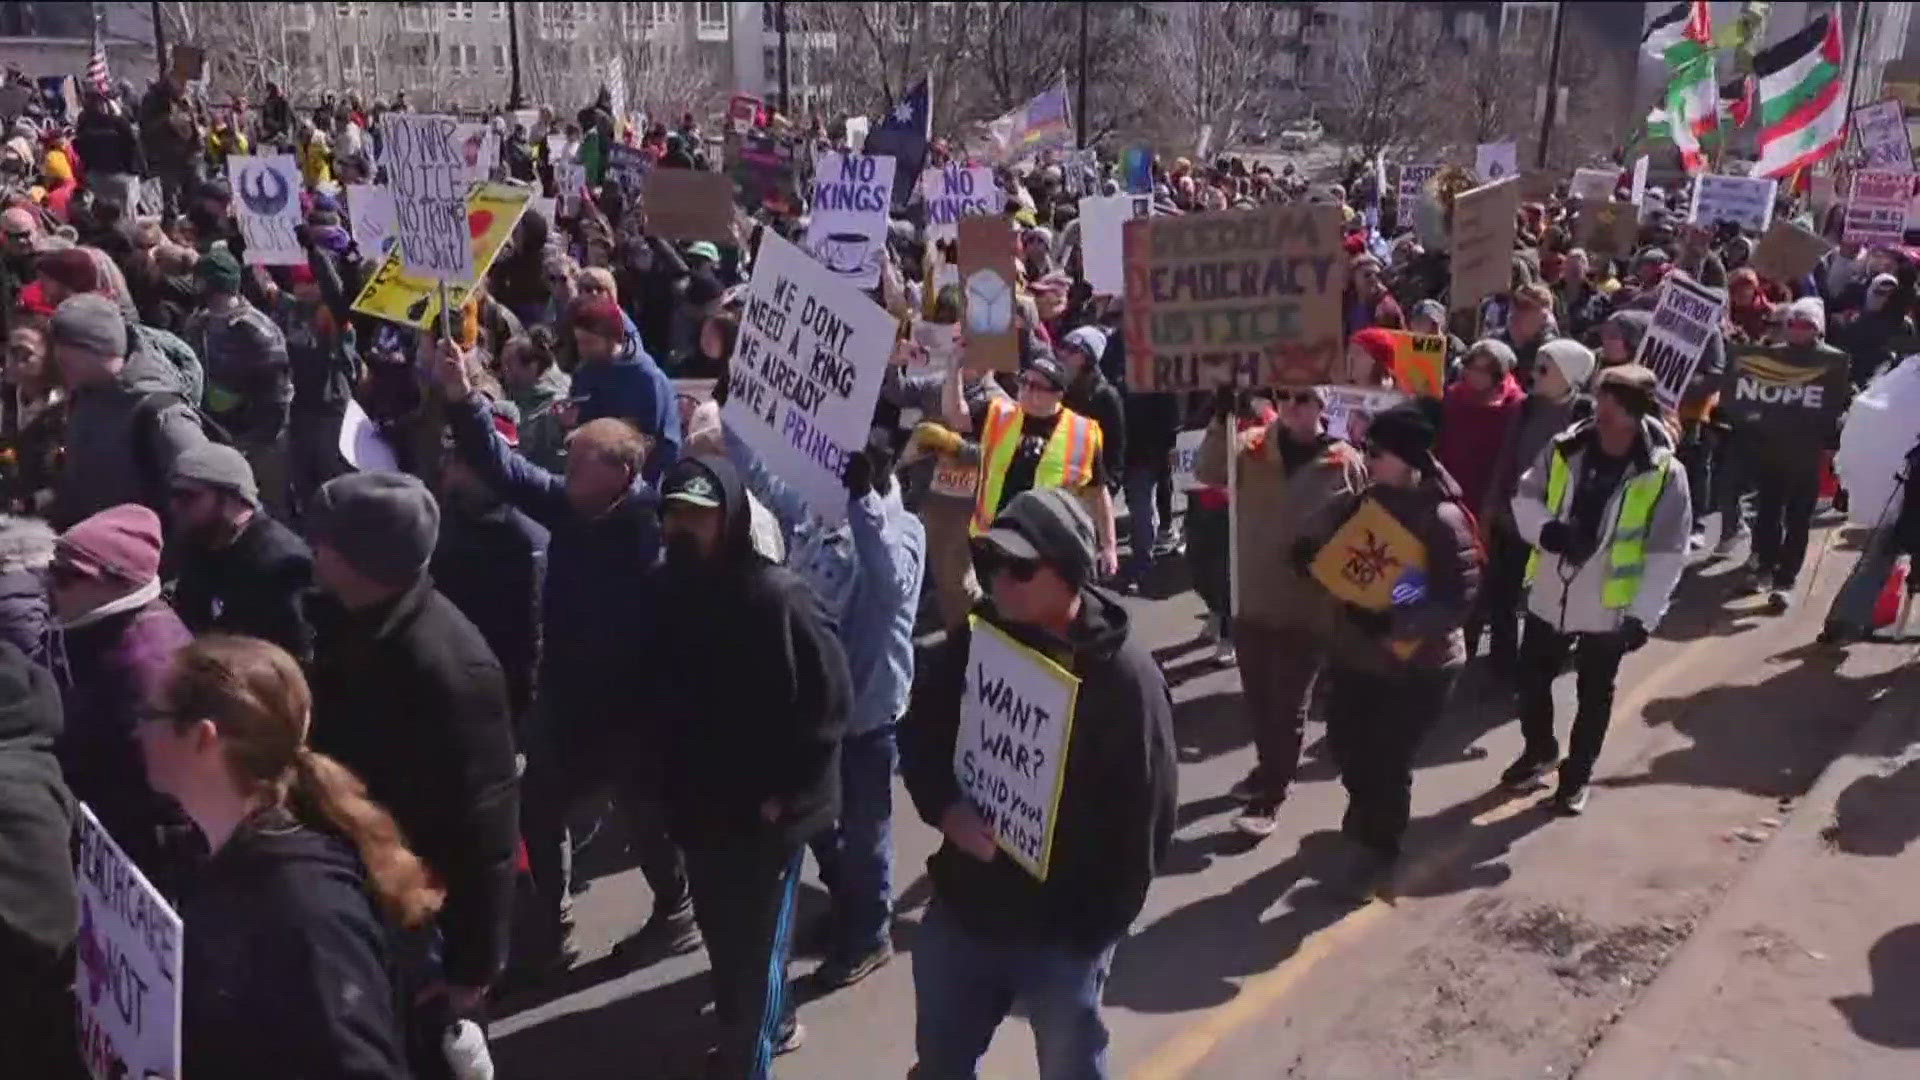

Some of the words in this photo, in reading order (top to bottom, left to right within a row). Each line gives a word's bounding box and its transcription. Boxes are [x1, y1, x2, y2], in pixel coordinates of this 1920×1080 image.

[380, 113, 411, 163] NO
[415, 117, 461, 168] WAR
[390, 160, 415, 198] NO
[417, 163, 464, 202] ICE
[840, 155, 876, 183] NO
[944, 162, 975, 196] NO
[395, 197, 419, 234] NO
[419, 198, 466, 236] TRUMP
[815, 182, 887, 212] KINGS
[400, 232, 424, 266] NO
[774, 275, 798, 313] WE
[1130, 253, 1334, 303] DEMOCRACY
[747, 293, 786, 342] NEED
[787, 327, 800, 360] A
[809, 346, 857, 398] KING
[1639, 335, 1694, 394] NOW
[739, 331, 760, 370] WE
[760, 351, 827, 418] ALREADY
[1735, 376, 1825, 409] NOPE
[729, 367, 766, 416] HAVE
[765, 400, 778, 430] A
[782, 406, 850, 480] PRINCE
[978, 662, 1050, 740] WANT
[981, 720, 1045, 779] WAR?
[106, 936, 149, 1037] NOT
